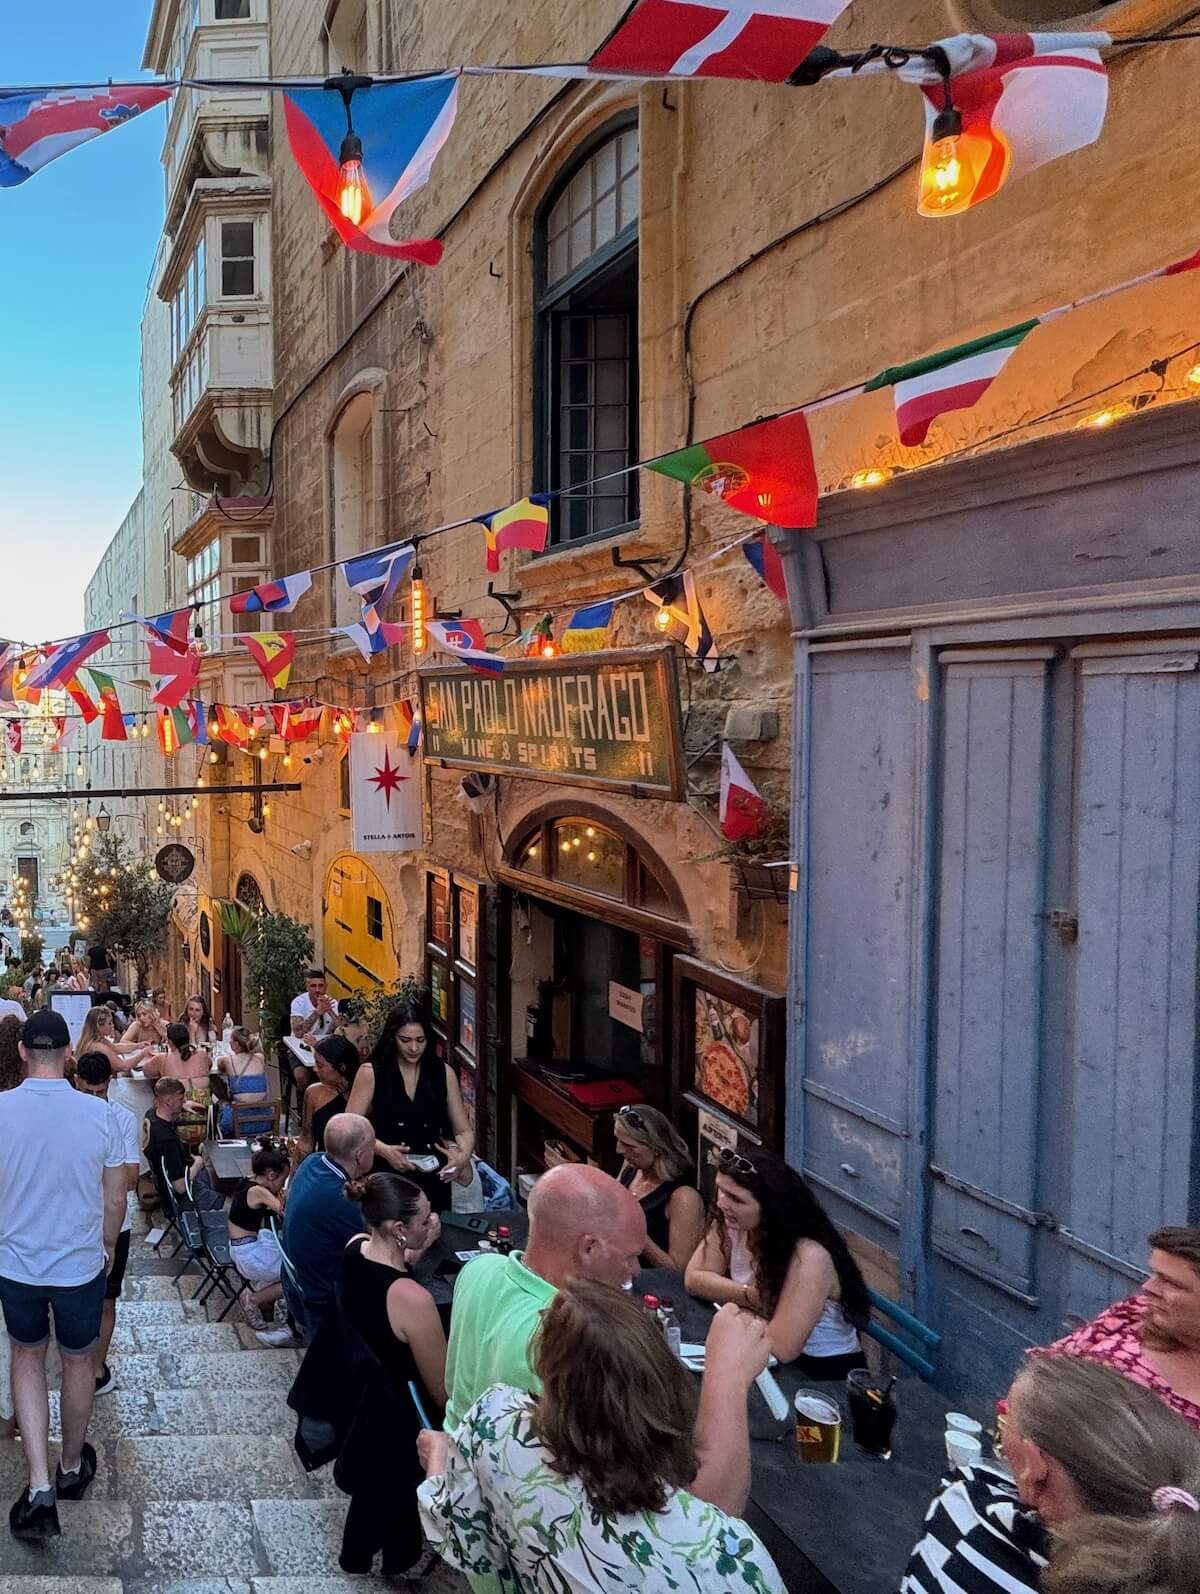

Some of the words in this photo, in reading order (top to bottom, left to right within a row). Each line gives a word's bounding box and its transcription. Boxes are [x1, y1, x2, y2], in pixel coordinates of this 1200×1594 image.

[427, 680, 458, 731] SAN
[461, 679, 520, 736] PAOLO
[521, 671, 650, 742] NAUFRAGO
[461, 737, 495, 760] WINE
[501, 741, 511, 761] &
[517, 741, 597, 771] SPIRITS
